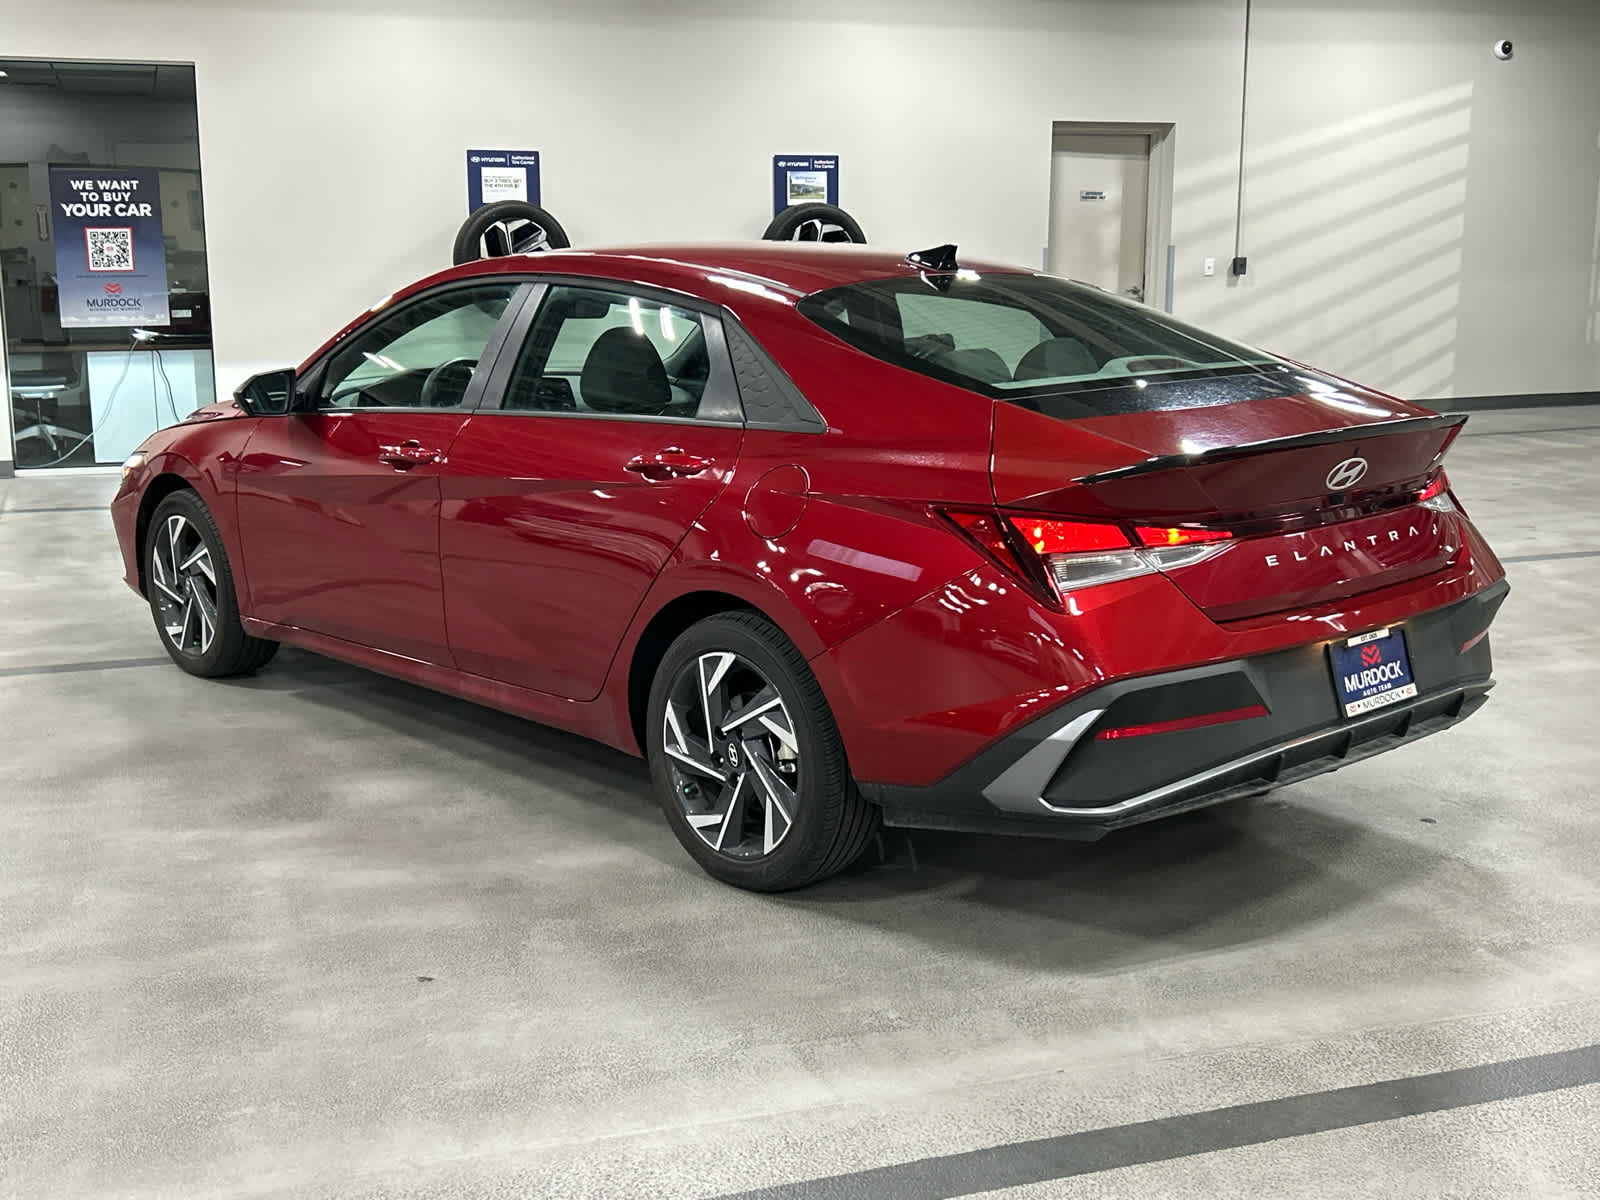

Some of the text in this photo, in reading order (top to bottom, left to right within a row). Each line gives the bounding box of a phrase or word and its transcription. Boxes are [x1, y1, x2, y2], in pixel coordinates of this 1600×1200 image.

[70, 180, 139, 190] WE WANT
[80, 192, 131, 202] TO BUY
[61, 203, 152, 217] YOUR CAR
[86, 297, 142, 308] MURDOCK
[1265, 526, 1419, 567] ELANTRA
[1344, 660, 1404, 693] MURDOCK
[1363, 682, 1392, 697] AUTO TEAM
[1362, 691, 1401, 709] MURDOCK
